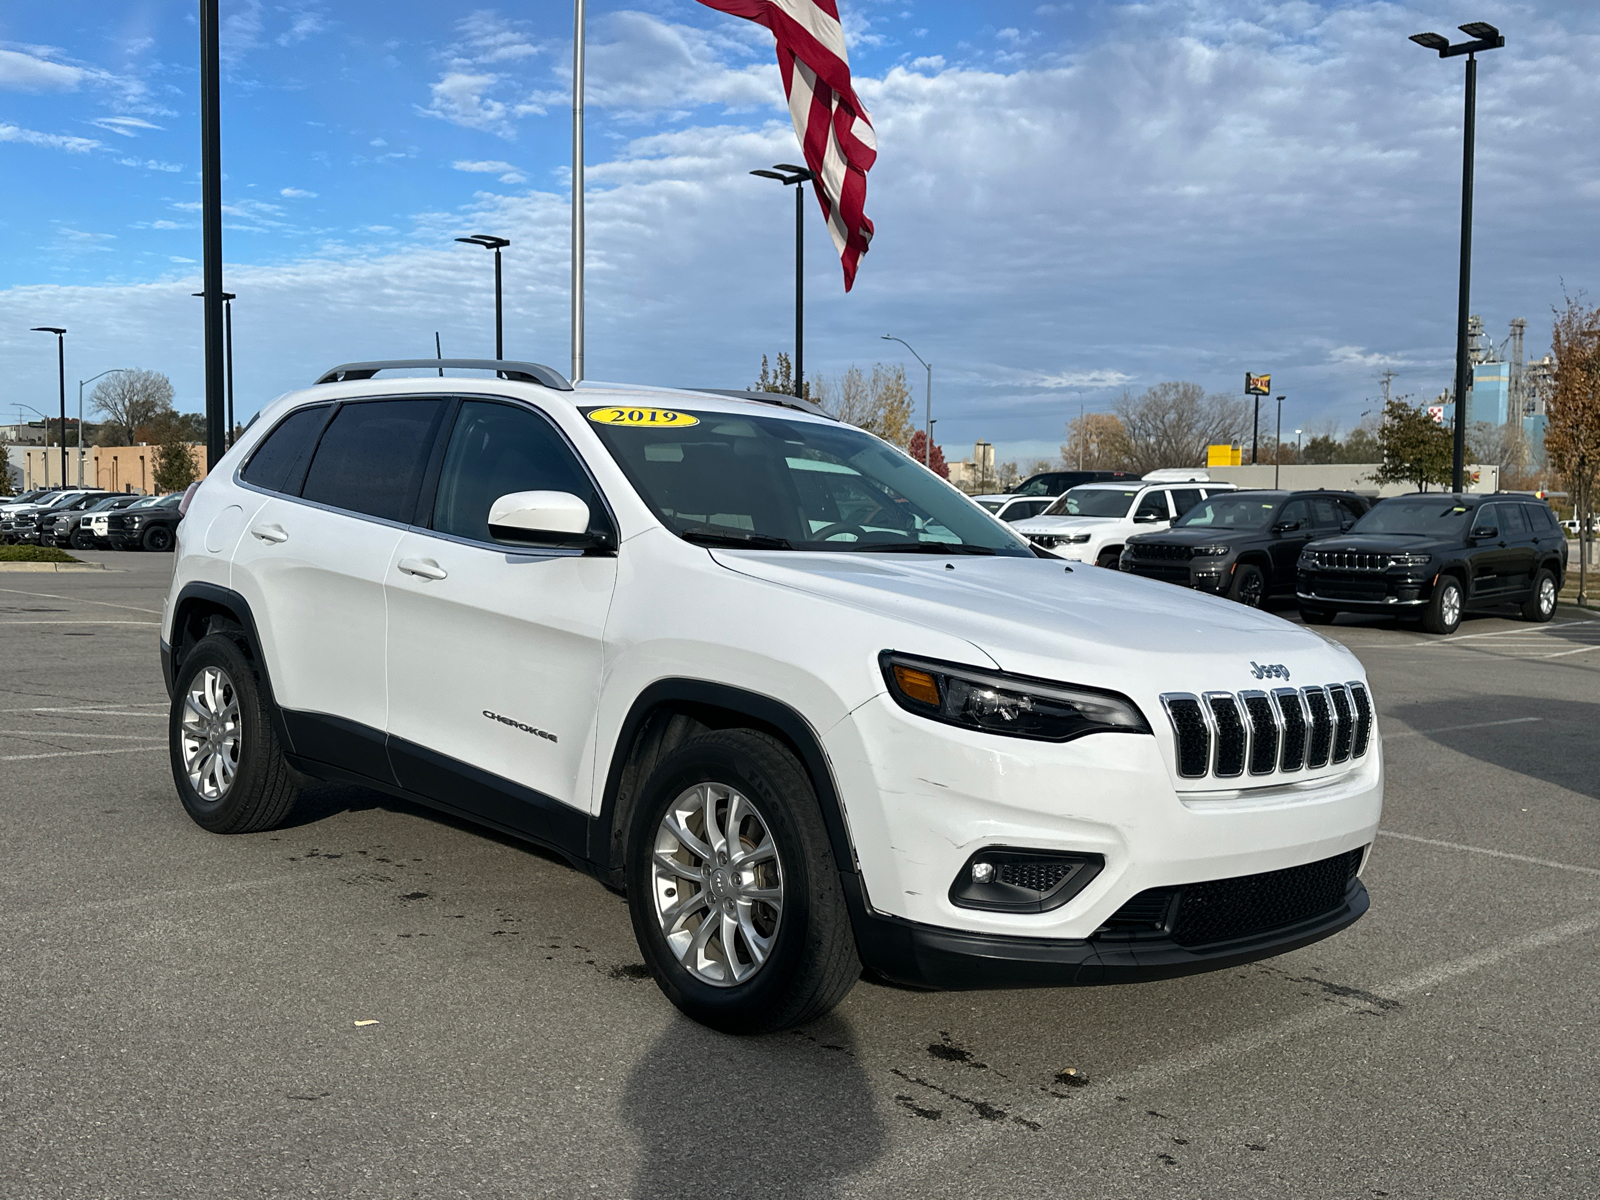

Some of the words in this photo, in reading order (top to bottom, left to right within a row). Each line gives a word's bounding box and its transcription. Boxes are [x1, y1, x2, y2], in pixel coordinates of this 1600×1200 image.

[611, 410, 677, 422] 2019
[1249, 660, 1291, 682] Jeep
[482, 710, 558, 743] CHEROKEE
